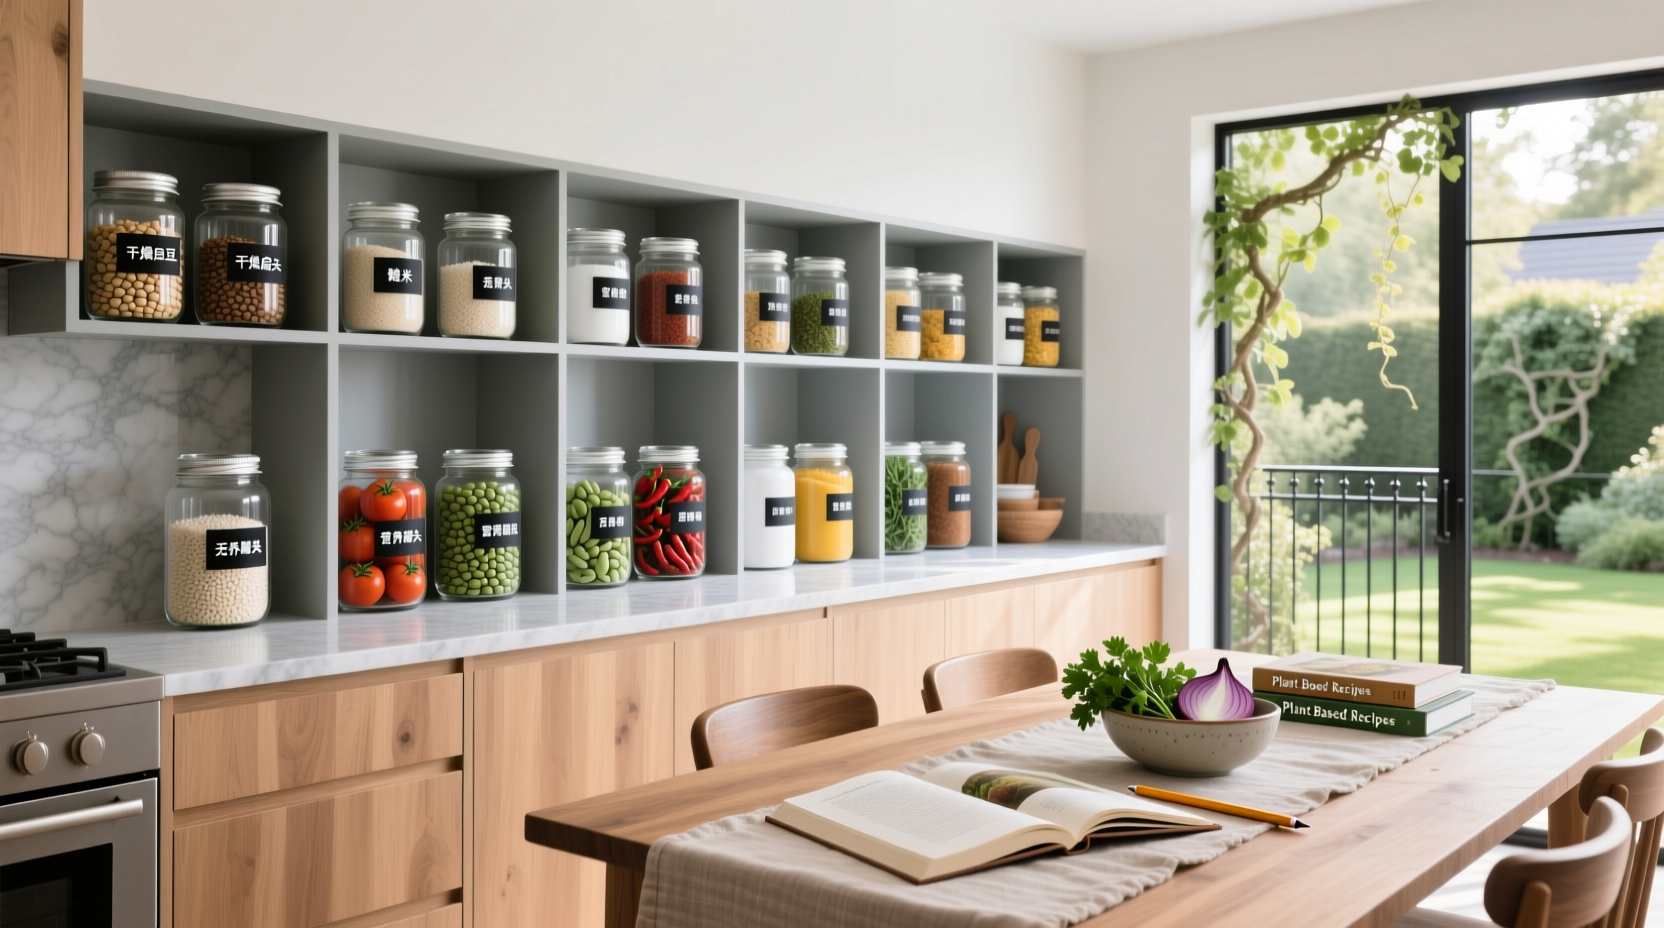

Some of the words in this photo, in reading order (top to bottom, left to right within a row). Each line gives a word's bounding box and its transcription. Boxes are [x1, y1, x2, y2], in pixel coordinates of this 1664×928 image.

[1272, 675, 1298, 689] Plant
[1282, 701, 1311, 716] Plant
[1313, 705, 1347, 721] Based
